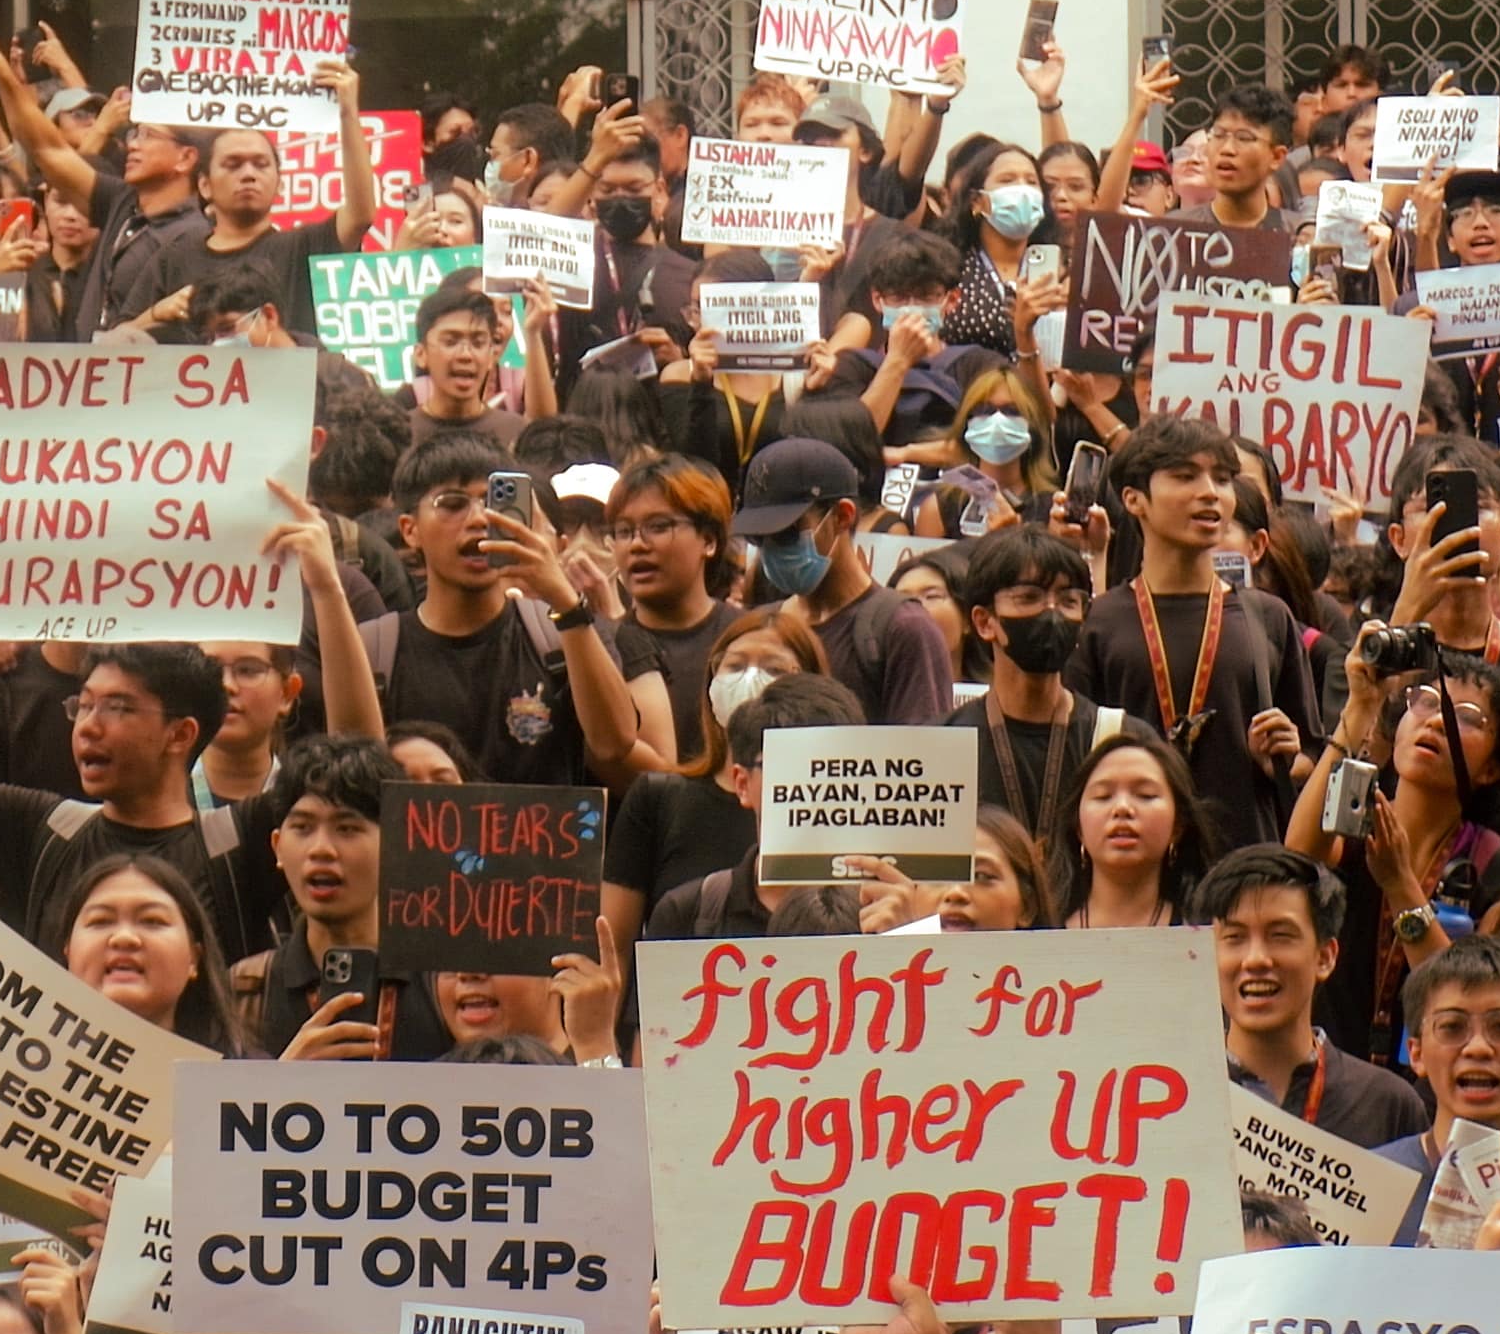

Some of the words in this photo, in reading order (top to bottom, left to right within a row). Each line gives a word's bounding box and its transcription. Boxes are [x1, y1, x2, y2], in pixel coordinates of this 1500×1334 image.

[173, 47, 306, 77] VIRATA
[1398, 109, 1438, 124] ISOLI
[1441, 108, 1479, 123] NIYO
[1398, 126, 1476, 142] NINAKAW
[1170, 304, 1402, 389] ITIGIL
[174, 354, 252, 405] SA
[1218, 372, 1281, 393] ANG
[148, 499, 212, 542] SA
[36, 617, 78, 639] ACE
[87, 617, 118, 639] UP
[809, 758, 875, 778] PERA
[884, 759, 923, 777] NG
[773, 784, 868, 807] BAYAN,
[876, 785, 964, 804] DAPAT
[788, 807, 946, 829] IPAGLABAN!
[407, 803, 461, 843] NO
[481, 804, 580, 858] TEARS
[388, 882, 444, 927] FOR
[448, 874, 598, 941] DUTERTE
[676, 943, 948, 1071] fight
[967, 965, 1103, 1036] for
[50, 1001, 136, 1074] THE
[61, 1052, 150, 1125] THE
[220, 1101, 326, 1154] NO
[344, 1104, 439, 1154] TO
[461, 1106, 594, 1158] 50B
[712, 1068, 1025, 1196] higher
[1048, 1064, 1189, 1167] UP
[2, 1121, 119, 1194] FREE
[262, 1170, 553, 1224] BUDGET
[198, 1235, 344, 1287] CUT
[360, 1237, 467, 1289] ON
[486, 1241, 608, 1292] 4Ps
[719, 1173, 1191, 1308] BUDGET!
